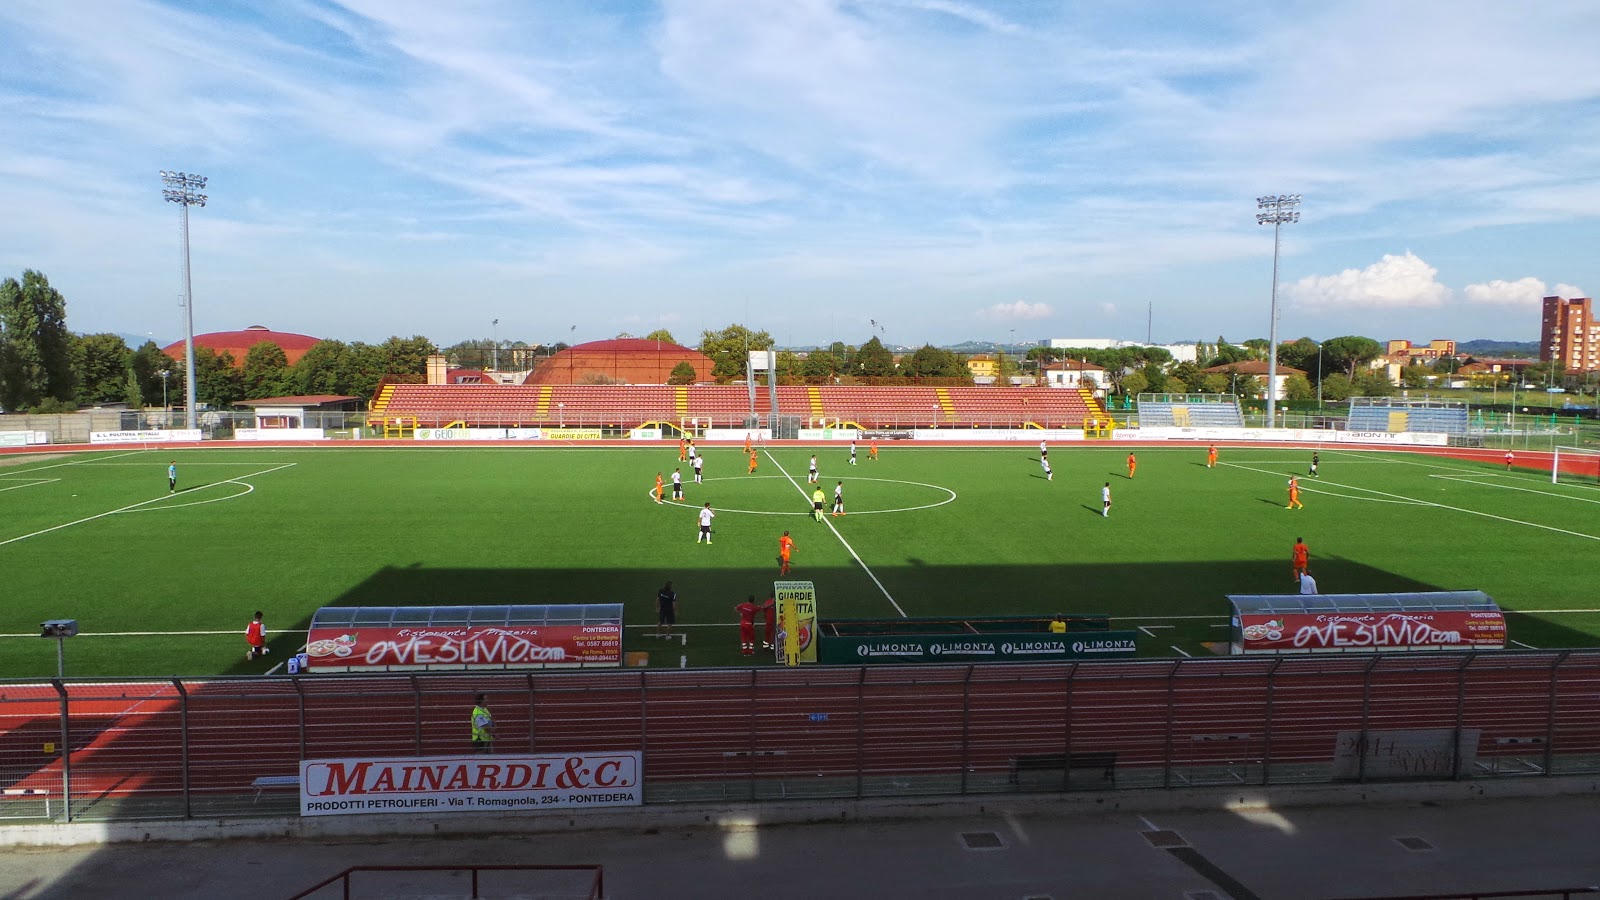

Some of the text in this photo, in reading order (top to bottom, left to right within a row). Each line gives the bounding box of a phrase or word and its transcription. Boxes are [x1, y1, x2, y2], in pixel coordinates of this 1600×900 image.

[434, 429, 470, 439] GEOFOR
[1316, 614, 1376, 622] Ristorante
[397, 627, 467, 637] Ristorante
[486, 627, 538, 636] Pizzeria
[869, 644, 924, 652] LIMONTA
[942, 643, 995, 651] LIMONTA
[1013, 641, 1066, 650] LIMONTA
[1084, 640, 1136, 649] LIMONTA
[319, 762, 551, 796] MAINARDI
[307, 800, 365, 811] PRODOTTI
[368, 798, 438, 809] PETROLIFERI
[449, 797, 464, 806] Via
[467, 796, 475, 806] T.
[478, 795, 539, 808] Romagnola,
[541, 795, 559, 804] 234
[569, 793, 634, 804] PONTEDERA
